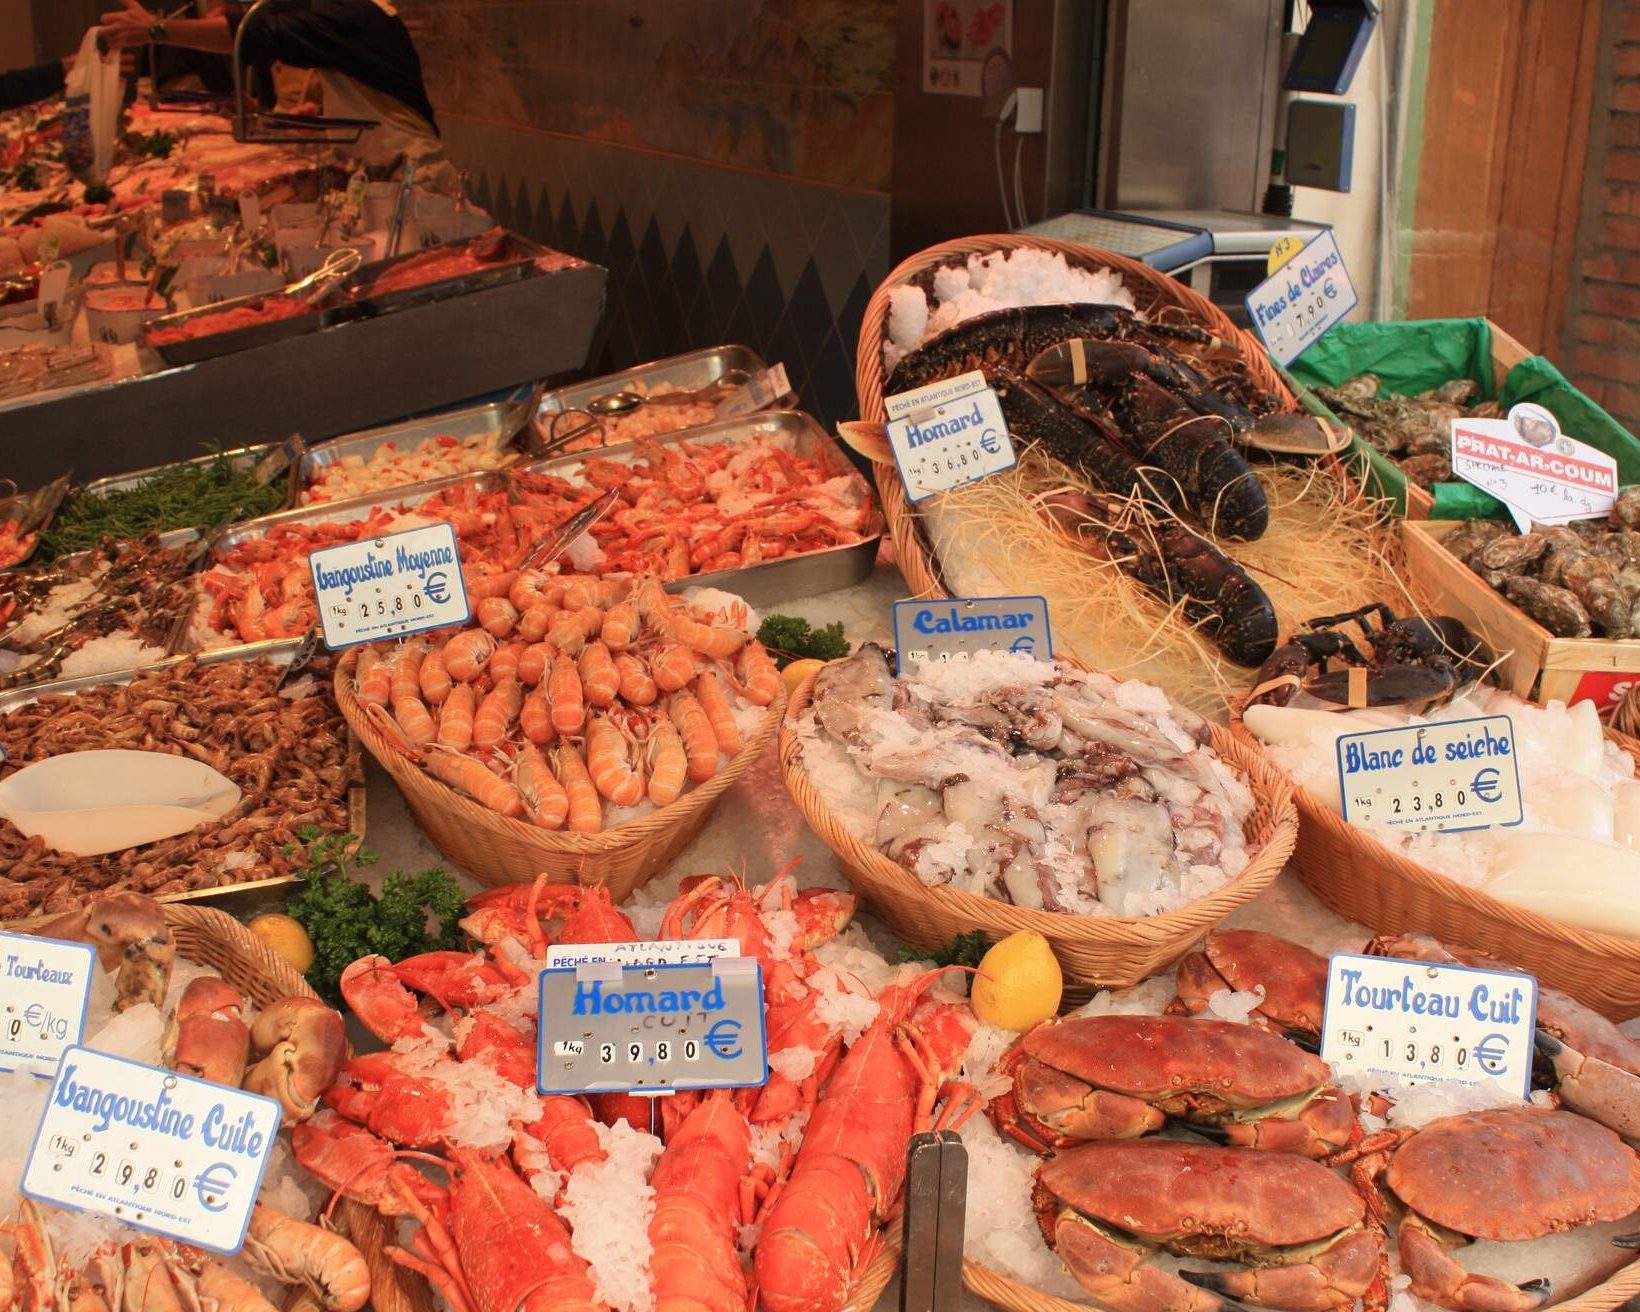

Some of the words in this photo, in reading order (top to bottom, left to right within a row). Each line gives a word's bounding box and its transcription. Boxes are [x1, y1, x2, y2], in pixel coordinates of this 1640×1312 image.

[1287, 281, 1302, 301] de
[905, 402, 984, 449] Homard
[1457, 434, 1613, 489] PRAT-AR-COUM
[316, 552, 394, 596] Langoustine
[396, 545, 454, 579] Moyenne
[332, 606, 347, 616] 1kg
[913, 608, 1034, 635] Calamar
[1346, 741, 1403, 773] Blanc
[1412, 734, 1437, 765] de
[1445, 726, 1511, 761] seiche
[1354, 797, 1372, 809] 1kg
[7, 954, 73, 985] Tourteaux
[572, 976, 726, 1015] Homard
[1341, 968, 1460, 1018] Tourteau
[1468, 984, 1523, 1024] Cuit
[643, 1012, 709, 1029] CUIT
[562, 1040, 582, 1055] 1kg
[1342, 1031, 1361, 1046] 1kg
[54, 1064, 195, 1140] Langoustine
[201, 1103, 264, 1158] Cuite
[55, 1136, 76, 1157] 1kg
